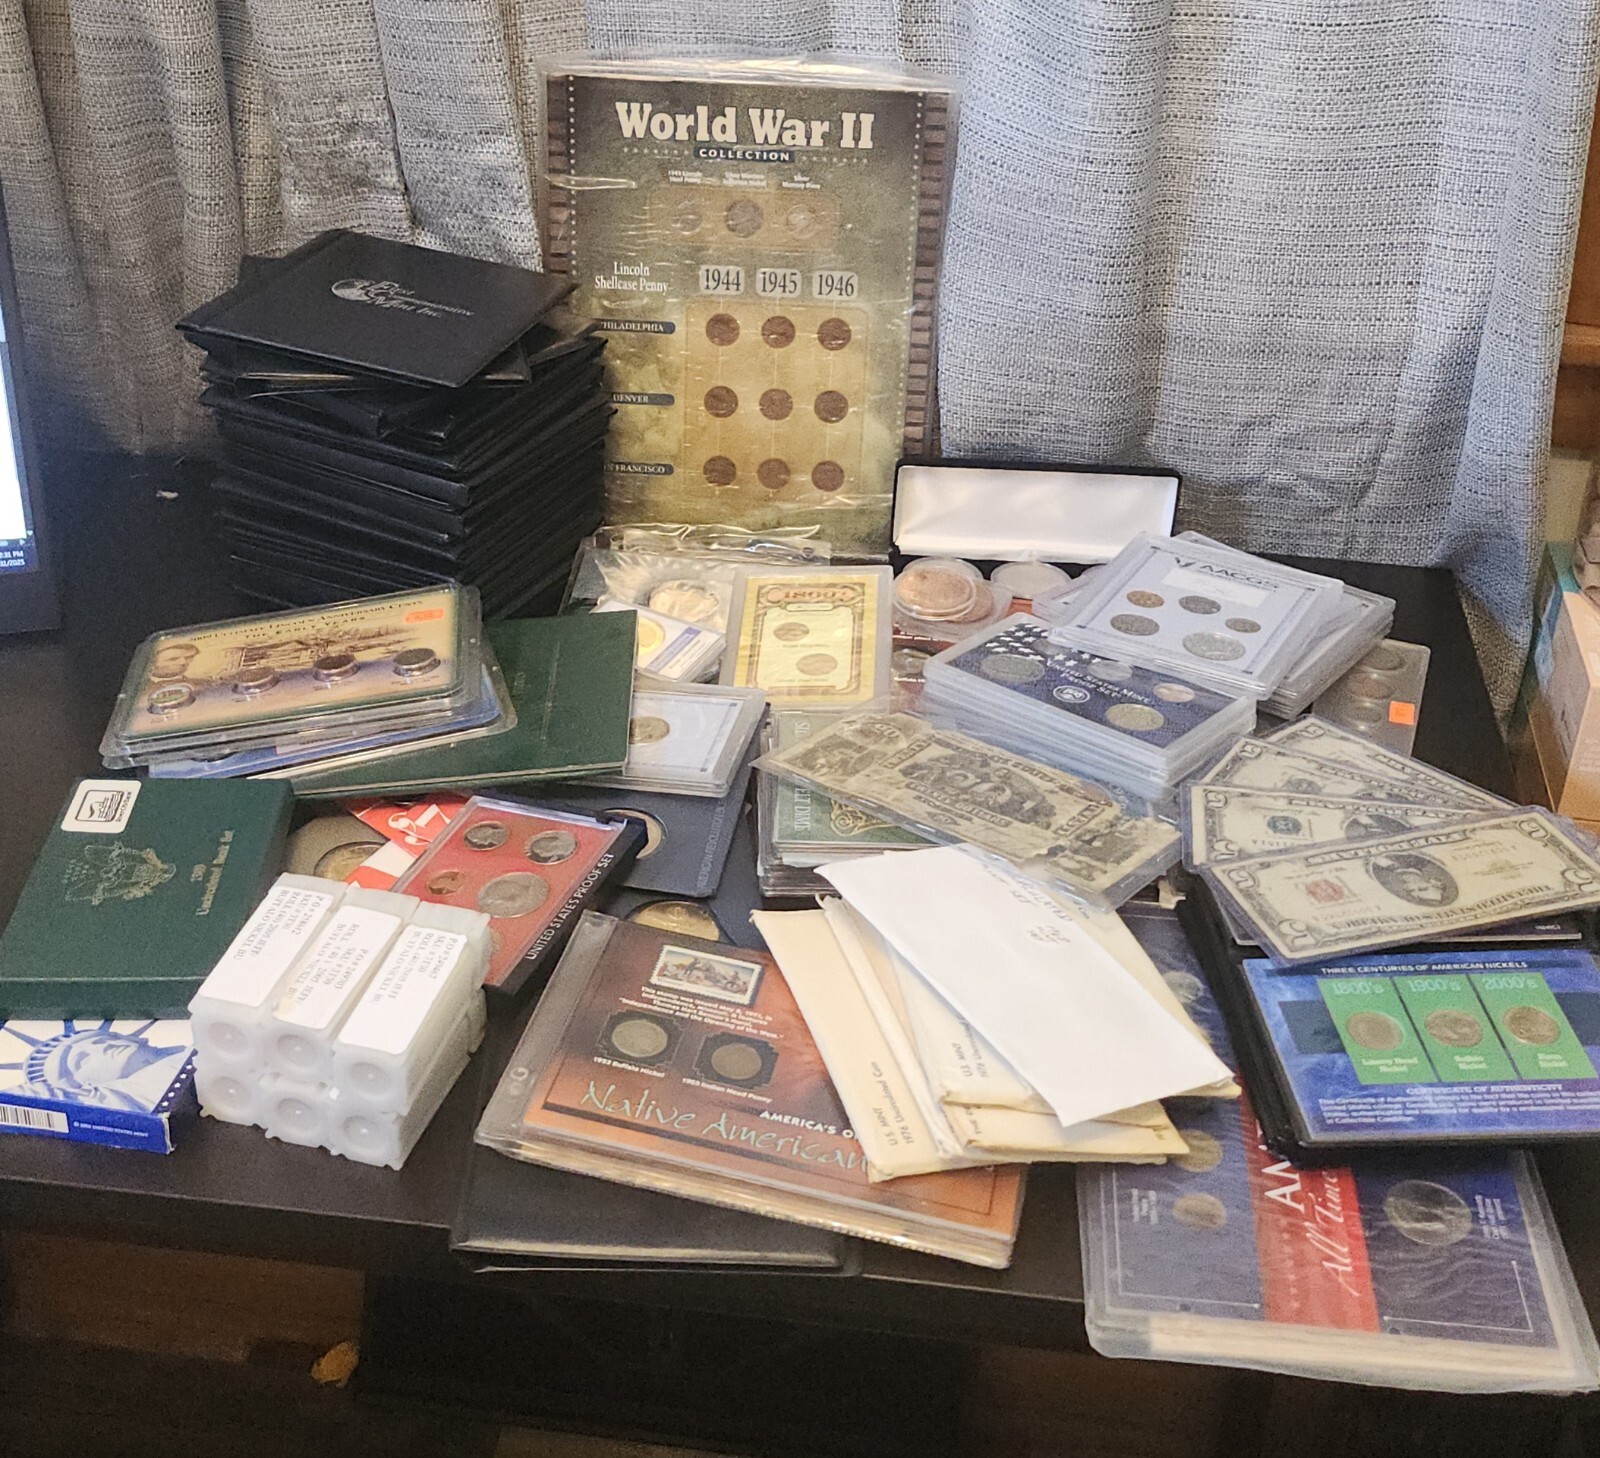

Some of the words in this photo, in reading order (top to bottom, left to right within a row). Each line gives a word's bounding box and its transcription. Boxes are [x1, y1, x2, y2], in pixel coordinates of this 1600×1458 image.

[616, 102, 737, 144] World
[749, 109, 829, 147] War
[840, 112, 875, 149] II
[700, 148, 790, 162] COLLECTION
[613, 261, 650, 276] Lincoln
[595, 275, 637, 290] Shellcase
[640, 277, 669, 296] Penny
[703, 268, 741, 291] 1944
[760, 271, 798, 294] 1945
[817, 274, 855, 297] 1946
[601, 321, 664, 332] HILADELPHIA
[613, 393, 649, 404] DENVER
[615, 464, 666, 474] FRANCISCO
[12, 550, 24, 558] PM
[325, 616, 366, 628] YEARS
[1121, 688, 1152, 703] MINT
[1206, 790, 1228, 809] 5
[795, 806, 811, 831] DIME
[1518, 819, 1550, 841] 5
[1214, 840, 1240, 861] 5
[1229, 869, 1257, 890] 5
[1562, 868, 1596, 894] 5
[260, 889, 289, 921] BUFFALO
[281, 891, 301, 909] ROLL
[525, 928, 556, 960] UNITED
[550, 898, 581, 929] STATES
[573, 868, 602, 899] PROOF
[597, 852, 615, 868] SET
[241, 922, 266, 948] NICKEL
[1278, 918, 1311, 946] 5
[295, 957, 320, 985] NICKEL
[1321, 964, 1356, 975] THREE
[1357, 963, 1414, 973] CENTURIES
[1415, 963, 1429, 972] OF
[1431, 962, 1483, 972] AMERICAN
[1485, 960, 1528, 970] NICKELS
[1331, 981, 1384, 995] 1800's
[1482, 976, 1538, 991] 2000's
[675, 1009, 690, 1019] and
[690, 1012, 703, 1021] the
[703, 1016, 735, 1030] Opening
[746, 1026, 759, 1035] the
[951, 1041, 966, 1062] MINT
[612, 1060, 640, 1073] Buffalo
[640, 1066, 666, 1079] Nickel
[701, 1082, 725, 1093] Indian
[726, 1087, 748, 1099] Head
[747, 1092, 773, 1105] Penny
[1407, 1086, 1472, 1095] CERTIFICATE
[1473, 1086, 1487, 1094] OF
[1490, 1083, 1563, 1093] AUTHENTICITY
[580, 1081, 697, 1129] Native
[701, 1112, 868, 1173] American
[760, 1110, 837, 1136] AMERICA'S
[842, 1129, 861, 1141] O
[872, 1106, 890, 1128] MINT
[1304, 1218, 1360, 1296] All
